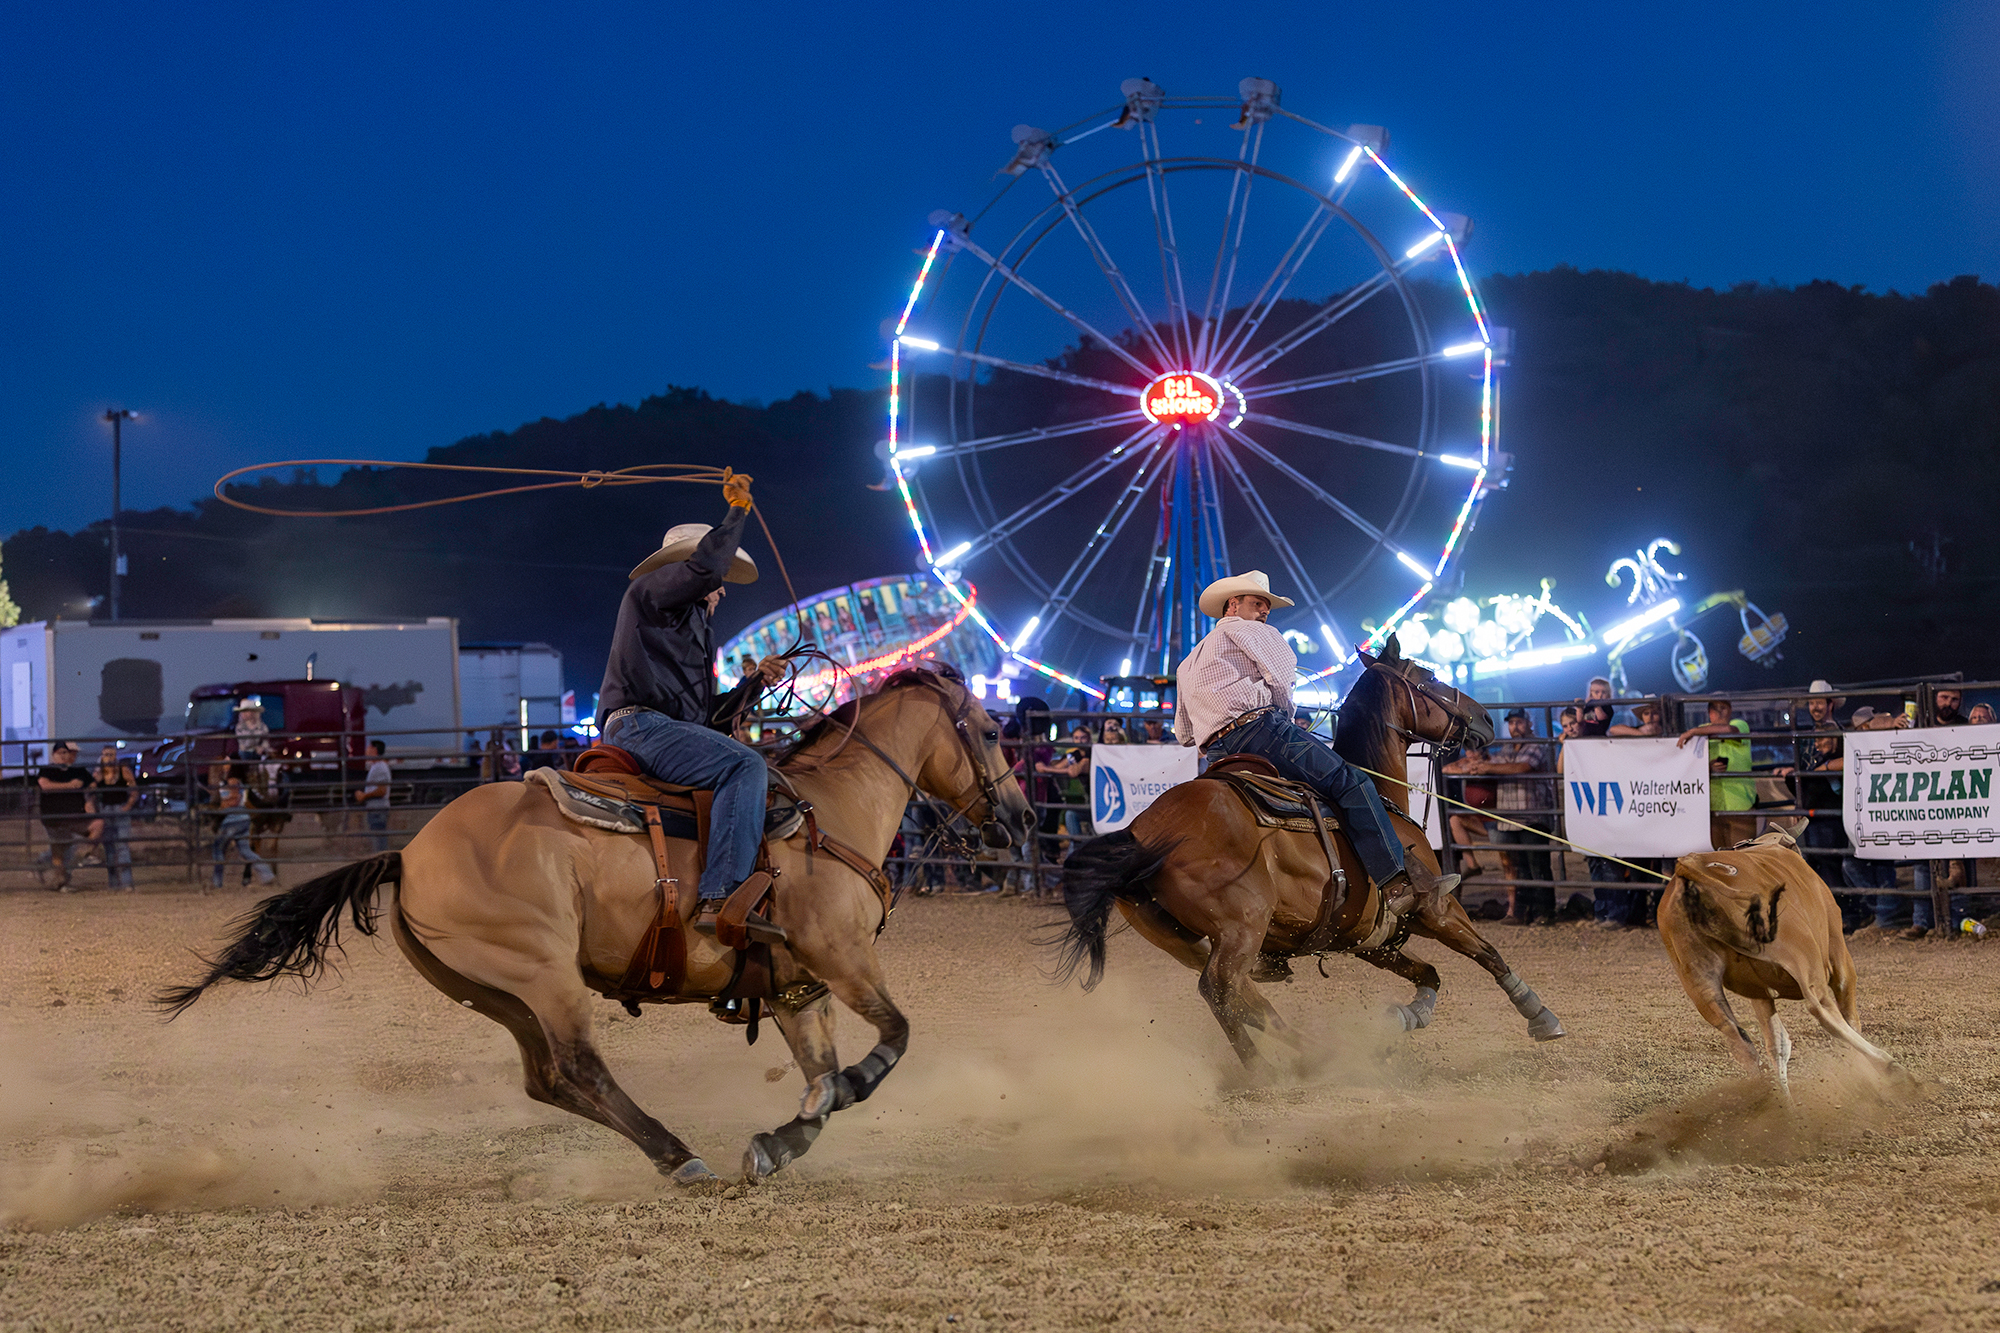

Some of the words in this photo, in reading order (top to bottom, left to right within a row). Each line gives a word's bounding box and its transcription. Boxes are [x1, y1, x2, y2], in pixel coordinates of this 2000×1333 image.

[1151, 396, 1213, 415] SHOWS
[1630, 779, 1705, 795] WalterMark
[1868, 768, 1992, 803] KAPLAN
[1629, 799, 1677, 817] Agency
[1868, 809, 1926, 822] TRUCKING
[1928, 806, 1990, 820] COMPANY
